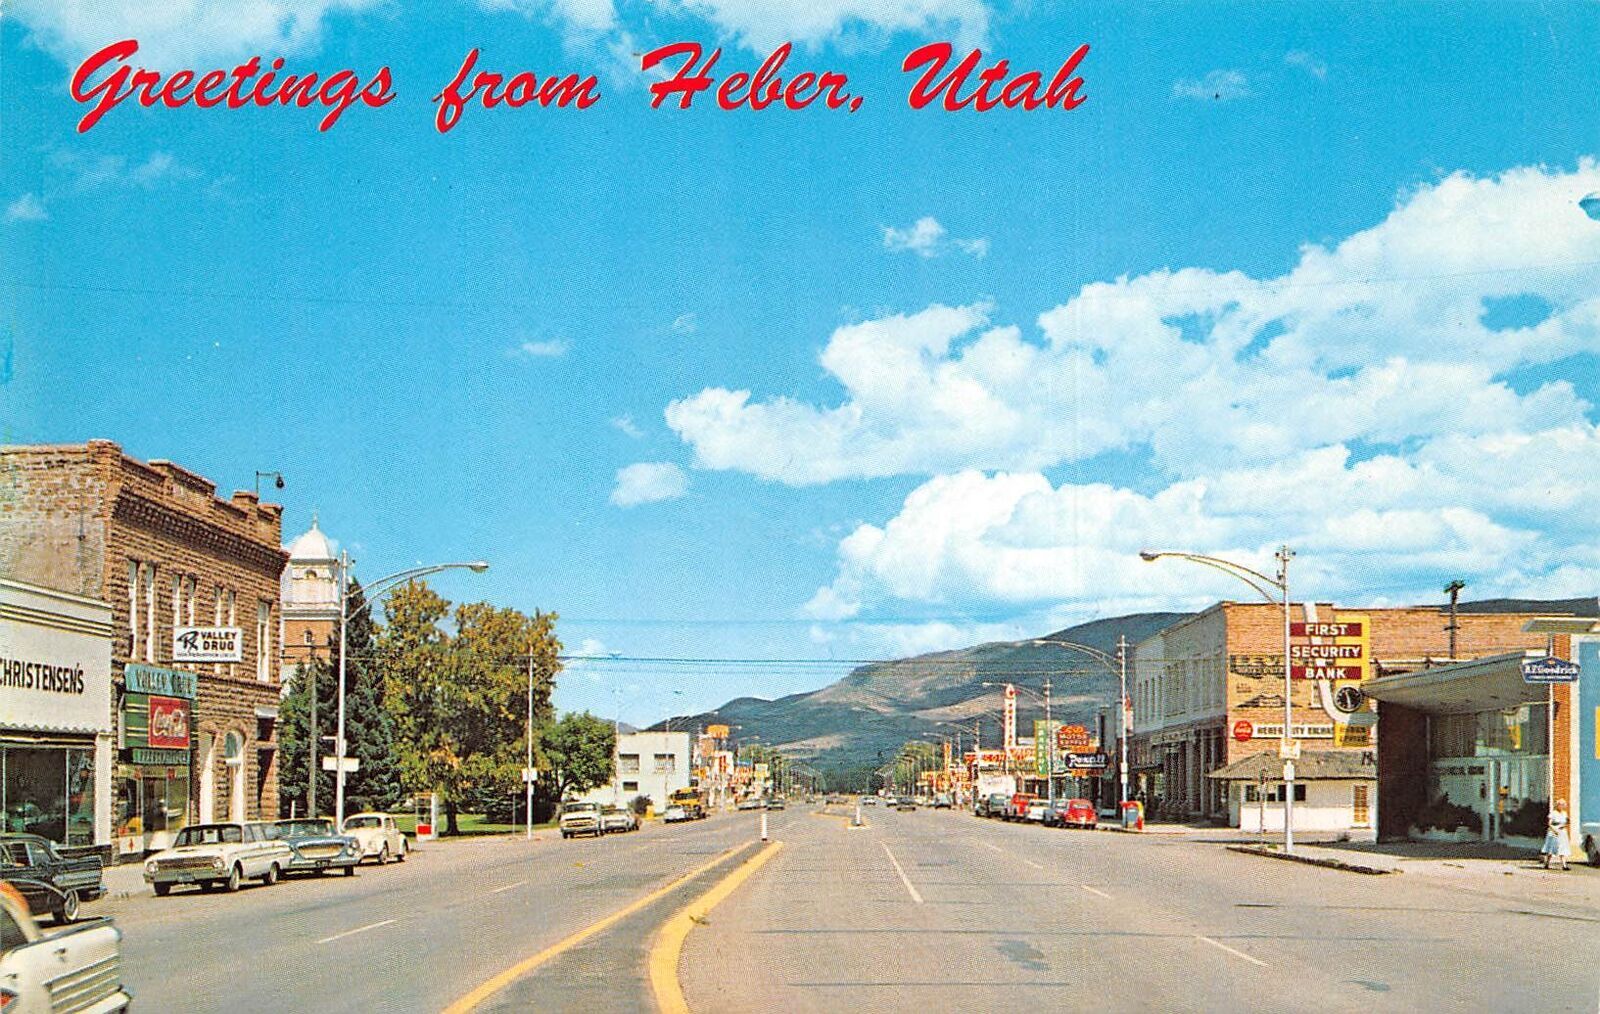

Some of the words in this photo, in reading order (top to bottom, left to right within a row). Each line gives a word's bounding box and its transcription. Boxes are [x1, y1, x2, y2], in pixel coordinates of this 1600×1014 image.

[200, 631, 238, 640] VALLEY
[1305, 624, 1348, 636] FIRST
[202, 640, 235, 651] DRUG
[1292, 646, 1360, 658] SECURITY
[1305, 670, 1347, 679] BANK
